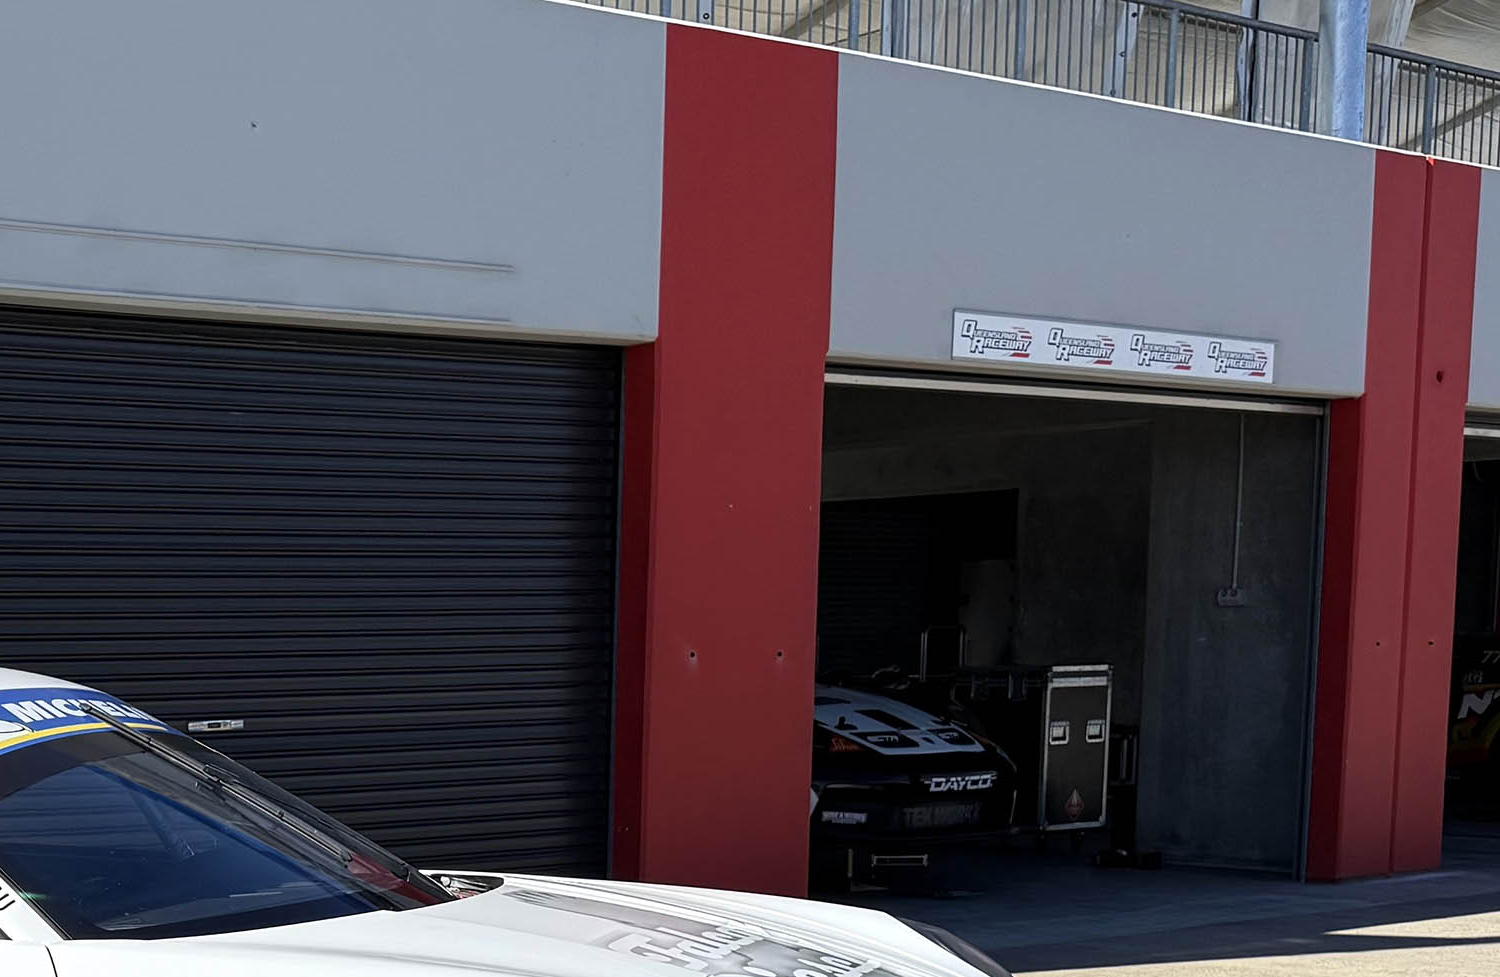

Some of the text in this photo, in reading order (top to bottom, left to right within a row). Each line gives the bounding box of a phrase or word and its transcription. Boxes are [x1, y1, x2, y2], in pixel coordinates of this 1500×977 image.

[961, 320, 1018, 340] QUEENSLAND
[1048, 328, 1101, 348] QUEENSLAND
[970, 336, 1032, 354] RACEWAY
[1056, 345, 1115, 361] RACEWAY
[1138, 350, 1193, 366] RACEWAY
[1215, 358, 1267, 373] RACEWAY
[929, 773, 993, 792] DAYCO
